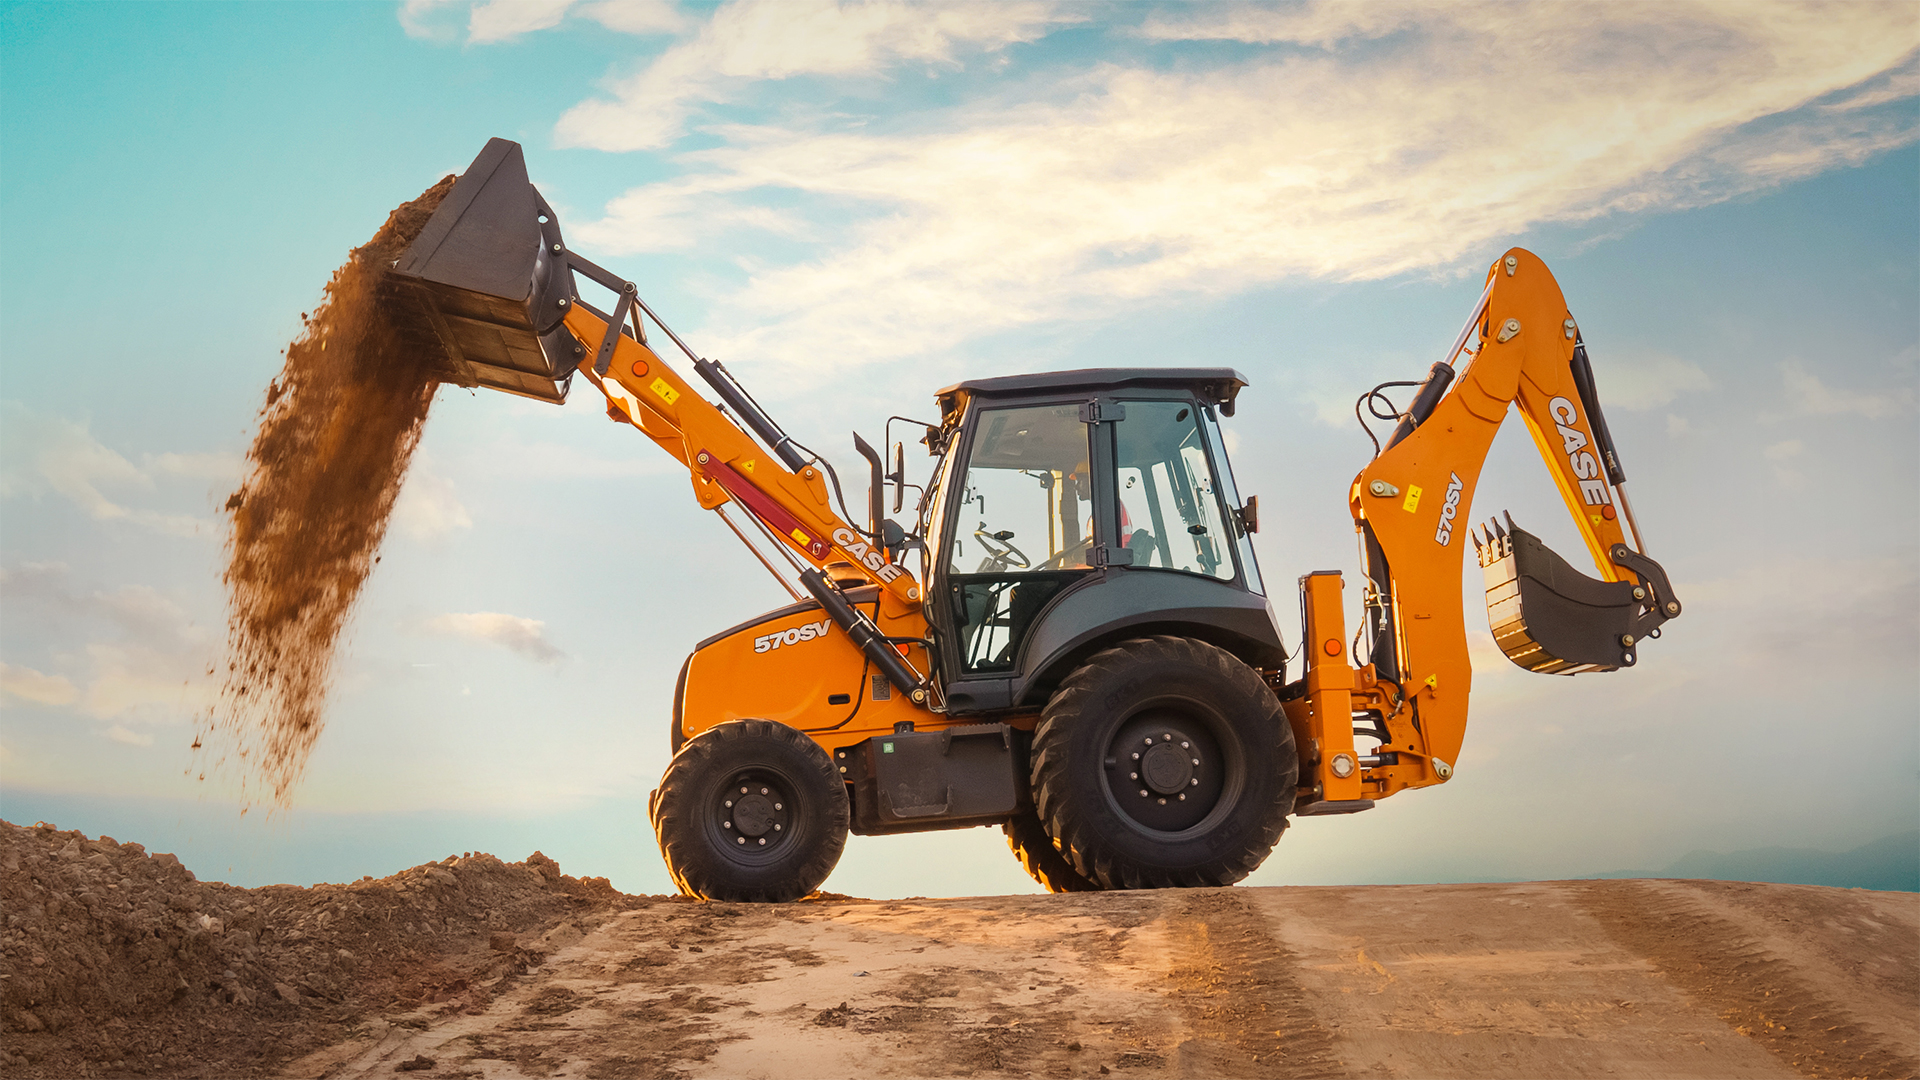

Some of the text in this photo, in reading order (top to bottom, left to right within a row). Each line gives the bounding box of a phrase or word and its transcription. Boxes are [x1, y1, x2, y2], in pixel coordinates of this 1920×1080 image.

[1549, 396, 1611, 506] CASE
[1435, 472, 1463, 546] 570SV
[832, 527, 902, 584] CASE
[754, 619, 832, 653] 570SV
